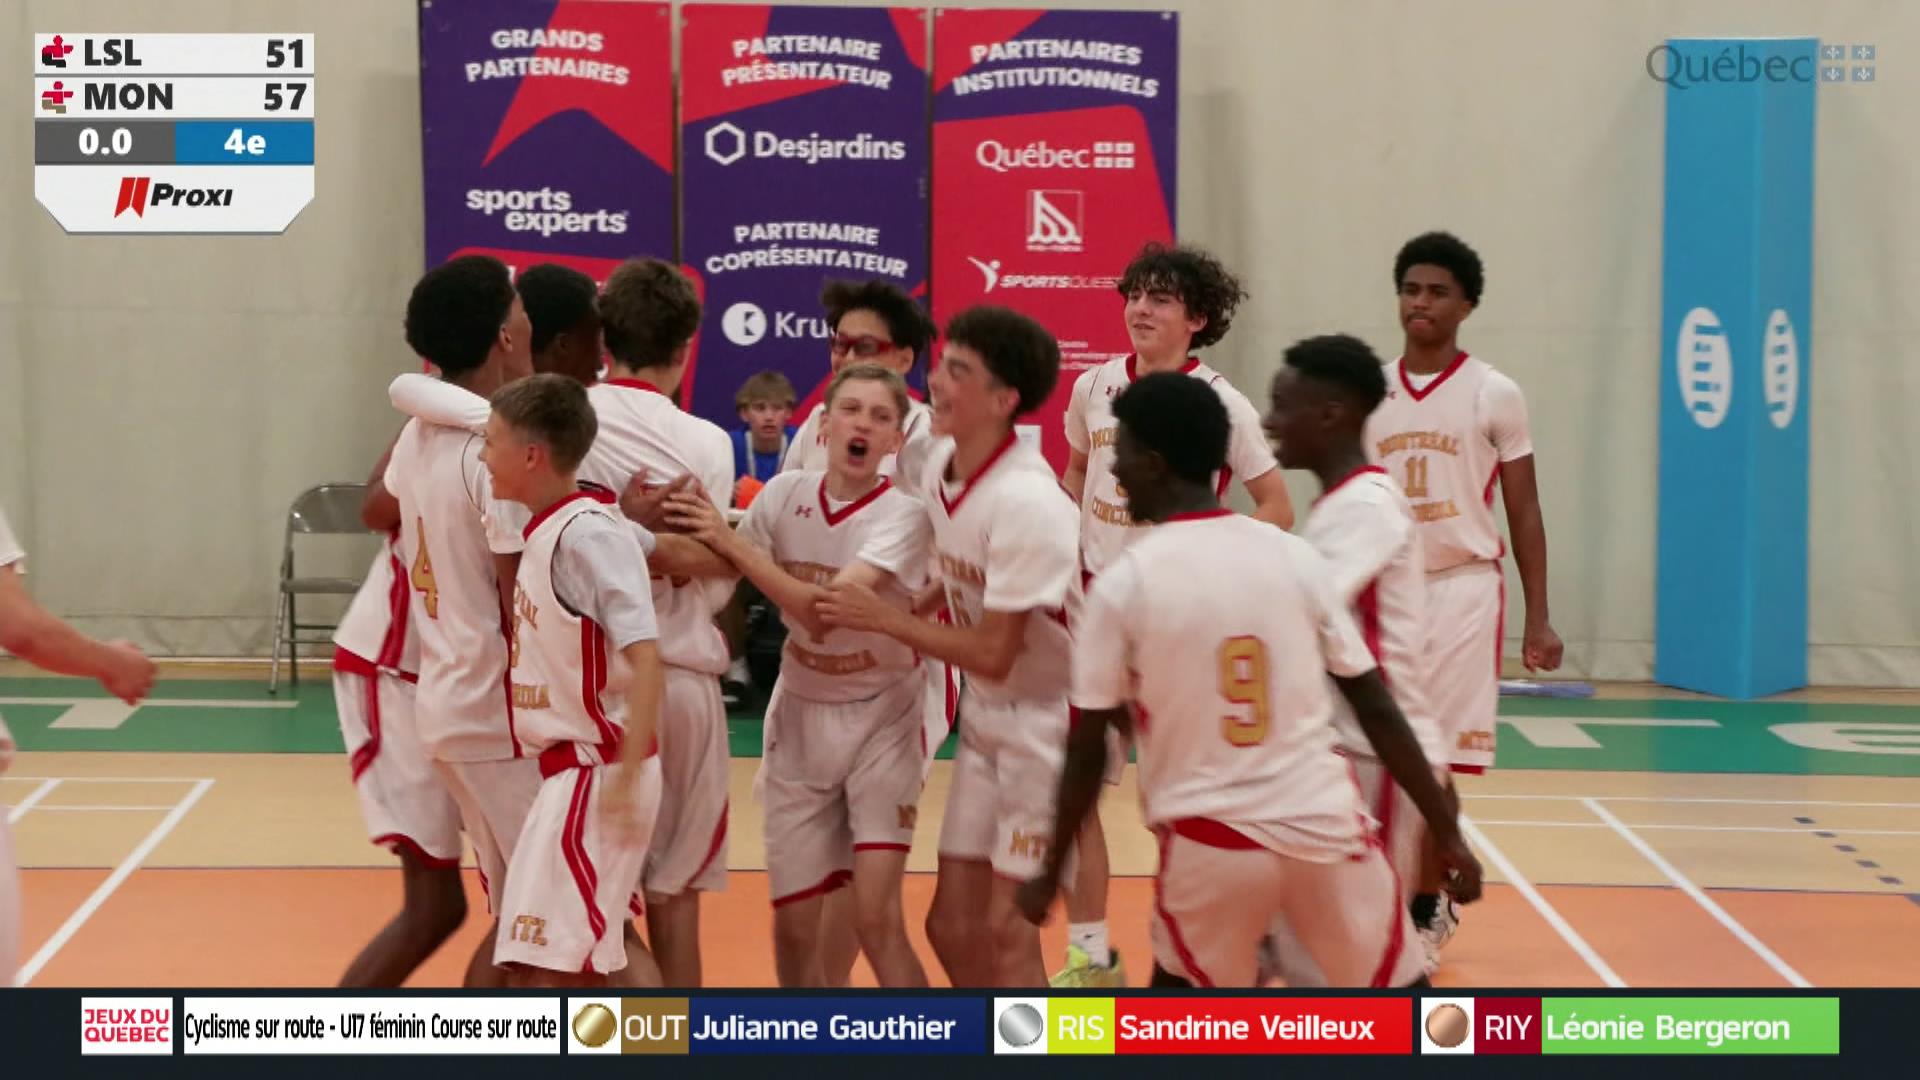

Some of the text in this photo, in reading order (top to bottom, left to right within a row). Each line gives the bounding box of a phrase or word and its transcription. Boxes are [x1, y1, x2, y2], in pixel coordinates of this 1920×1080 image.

[491, 29, 604, 52] GRANDS
[732, 35, 882, 60] PARTENAIRE
[970, 39, 1143, 65] PARTENAIRES
[465, 57, 630, 85] PARTENAIRES
[722, 59, 892, 90] PRÉSENTATEUR
[953, 67, 1160, 98] INSTITUTIONNELS
[754, 131, 906, 164] Desjardins
[976, 140, 1090, 172] Québec
[466, 187, 572, 215] sports
[505, 209, 629, 237] experts
[734, 222, 880, 246] PARTENAIRE
[706, 243, 908, 278] COPRÉSENTATEUR
[775, 311, 836, 338] Kru
[1404, 455, 1428, 498] 11
[411, 516, 439, 620] 4
[1217, 635, 1272, 747] 9
